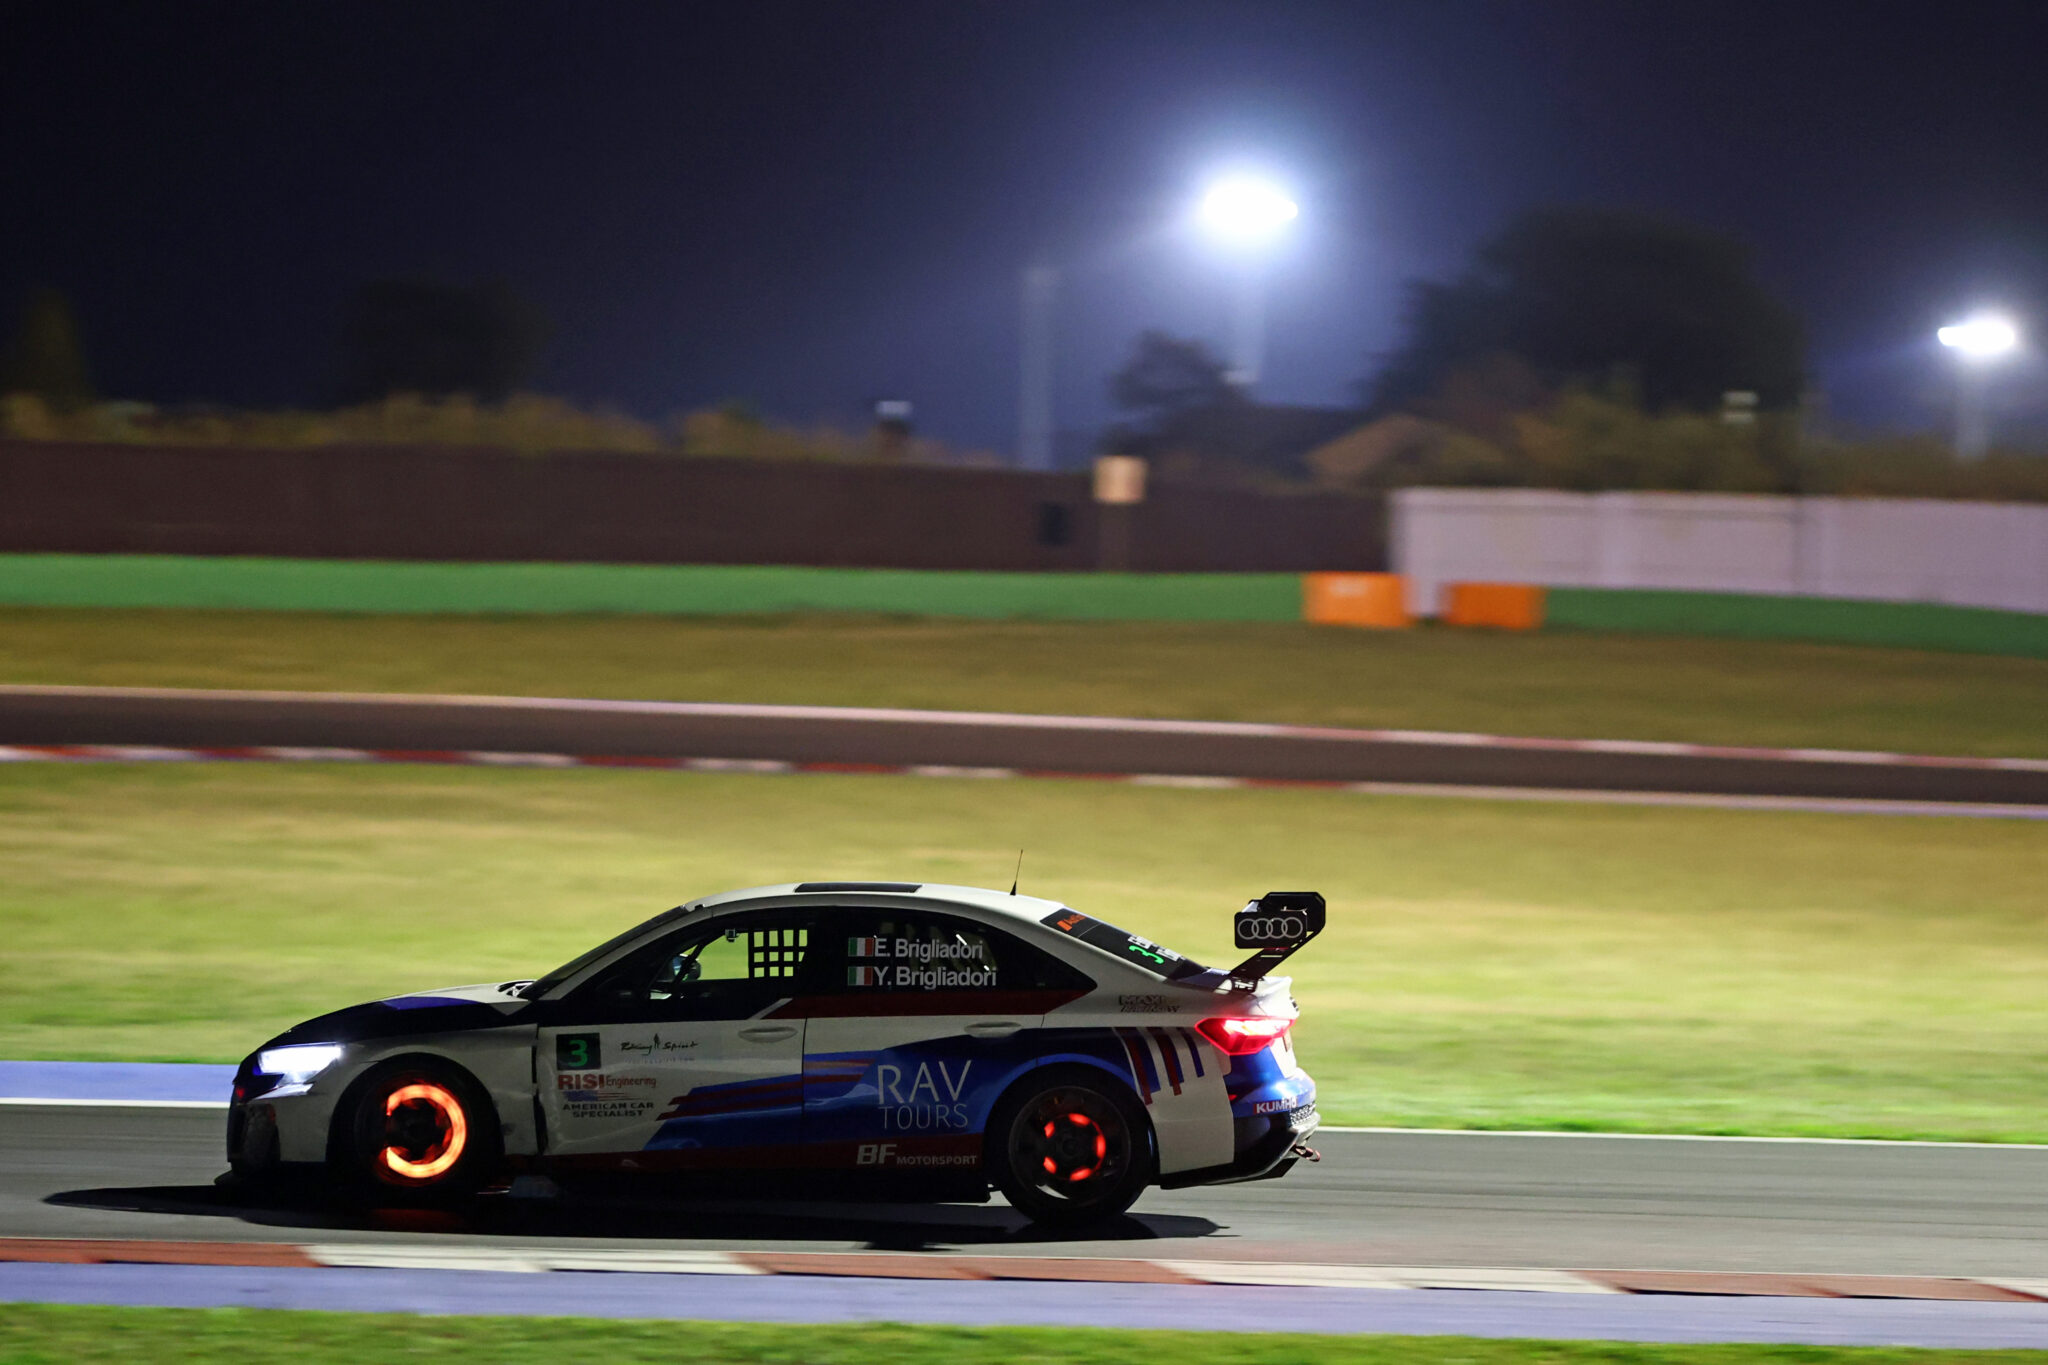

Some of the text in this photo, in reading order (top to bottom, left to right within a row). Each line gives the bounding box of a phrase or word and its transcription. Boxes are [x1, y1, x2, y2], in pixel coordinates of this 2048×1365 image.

[874, 938, 983, 963] E. Brigliadori
[873, 966, 997, 990] Y. Brigliadori
[567, 1039, 589, 1067] 3
[558, 1074, 657, 1090] RISI Engineering
[877, 1059, 972, 1105] RAV
[563, 1101, 654, 1111] AMERICAN CAR
[572, 1109, 643, 1118] SPECIALIST
[878, 1103, 969, 1130] TOURS
[1256, 1096, 1298, 1114] KUMHO
[857, 1143, 978, 1166] BF MOTORSPORT
